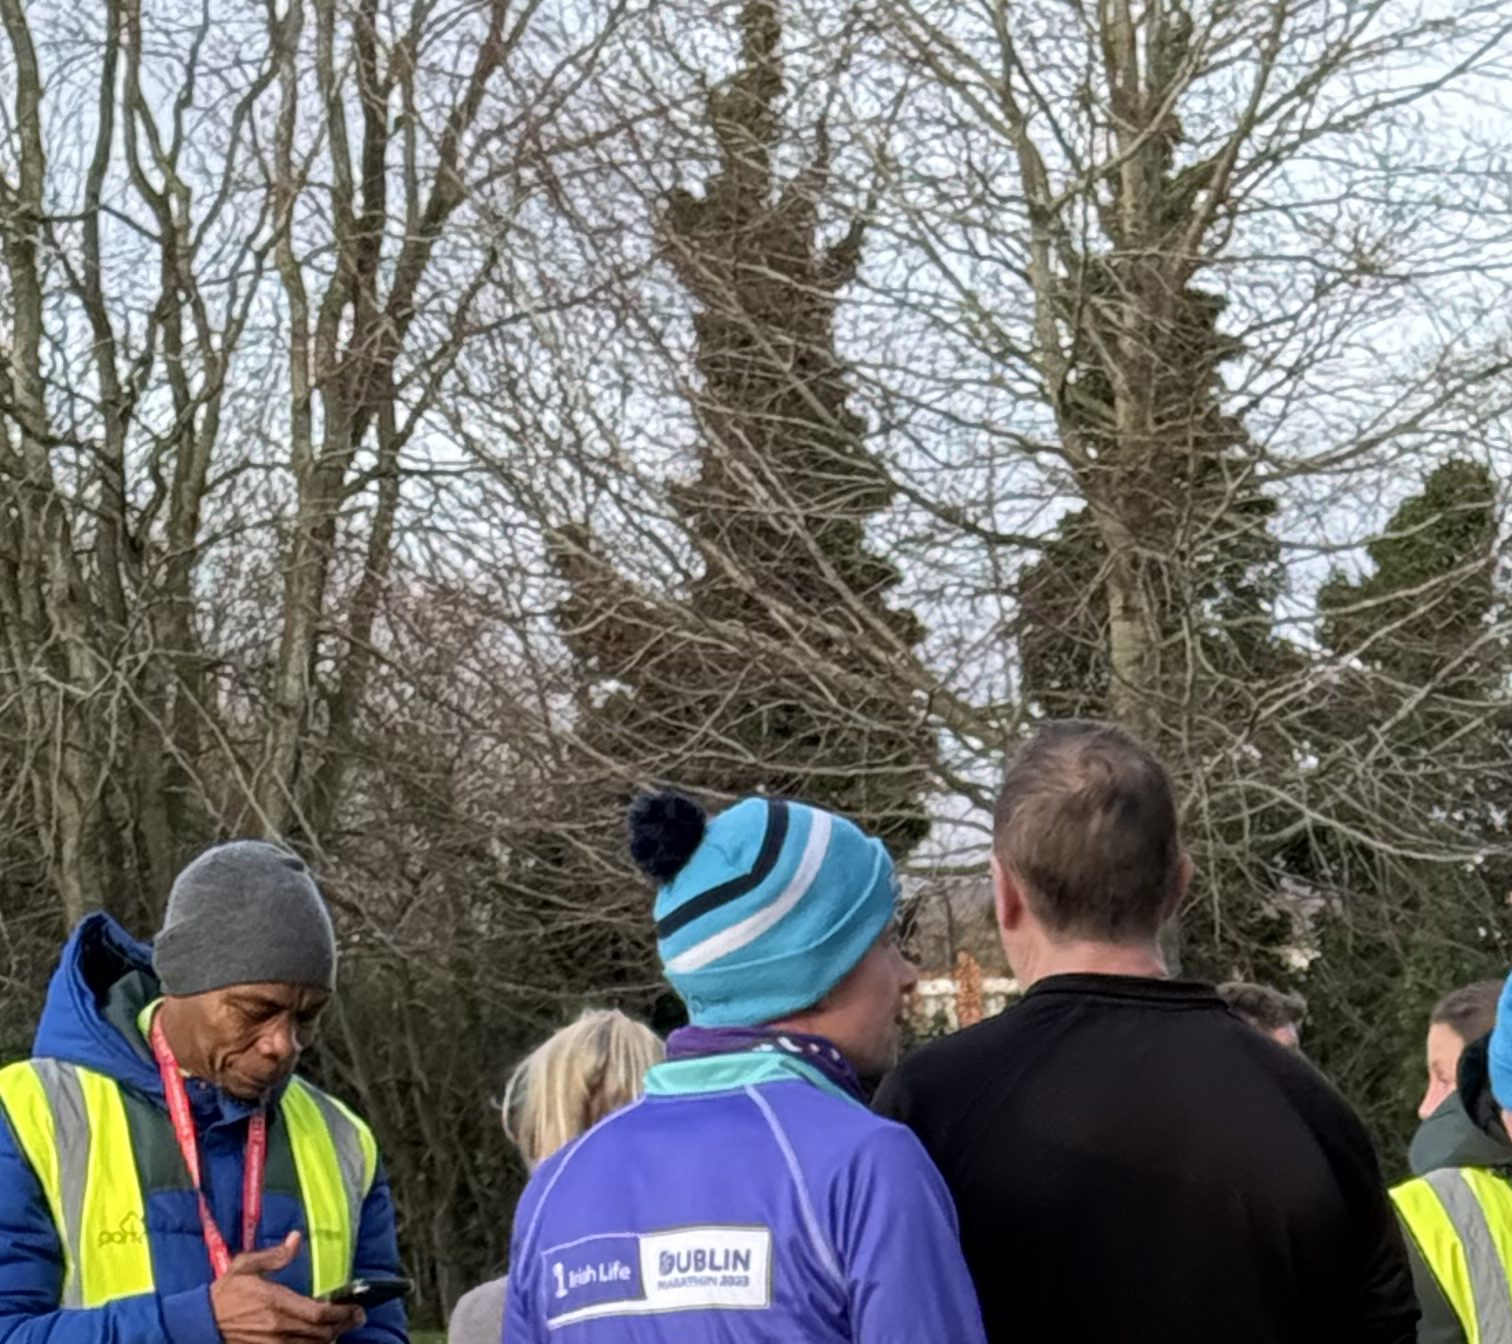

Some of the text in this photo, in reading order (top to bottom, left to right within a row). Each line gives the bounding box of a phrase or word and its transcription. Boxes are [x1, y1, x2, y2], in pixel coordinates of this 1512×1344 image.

[569, 1260, 632, 1289] Irish Life
[659, 1248, 751, 1277] DUBLIN
